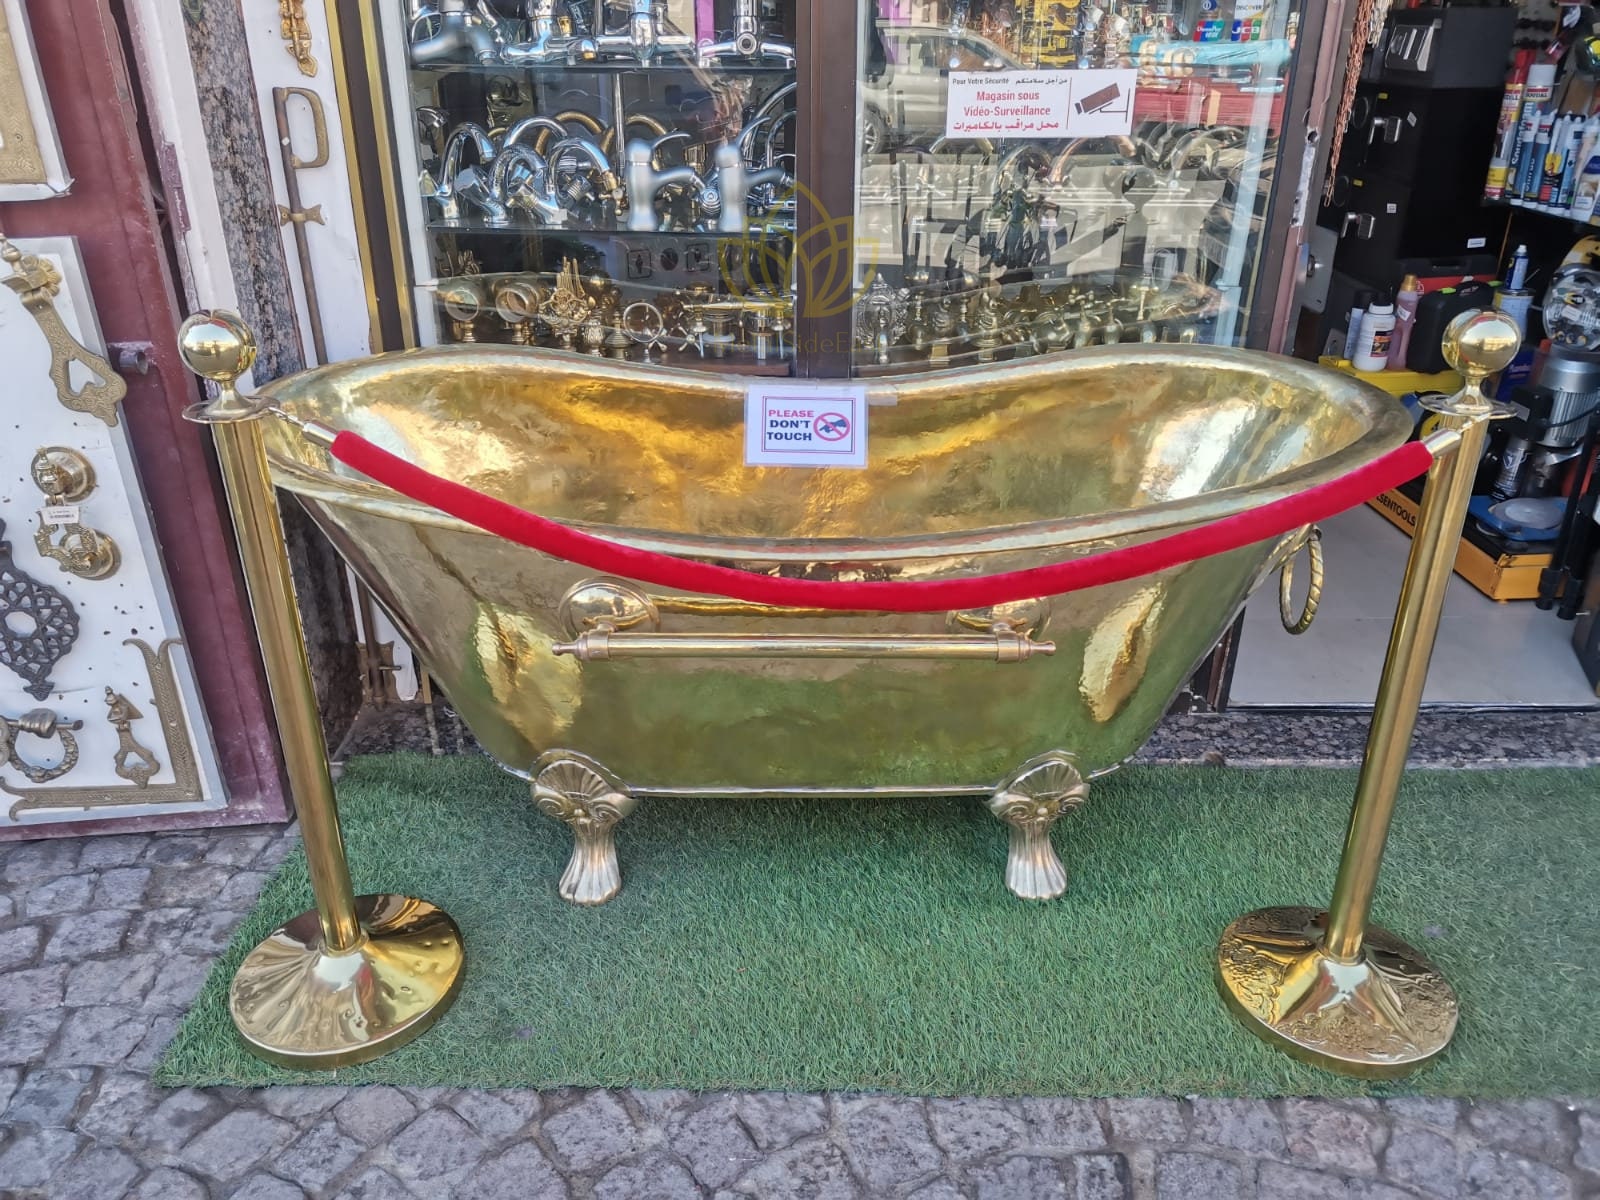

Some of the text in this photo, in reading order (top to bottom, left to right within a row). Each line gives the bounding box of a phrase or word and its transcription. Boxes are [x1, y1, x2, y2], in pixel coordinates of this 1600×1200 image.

[1231, 26, 1260, 34] JCB
[976, 90, 1040, 103] Magasin sous
[963, 105, 1051, 117] Vidéo-Surveillance
[953, 118, 1059, 132] محل مراقب بالكاميرات
[768, 409, 815, 418] PLEASE
[769, 419, 811, 429] DON'T
[766, 431, 812, 441] TOUCH
